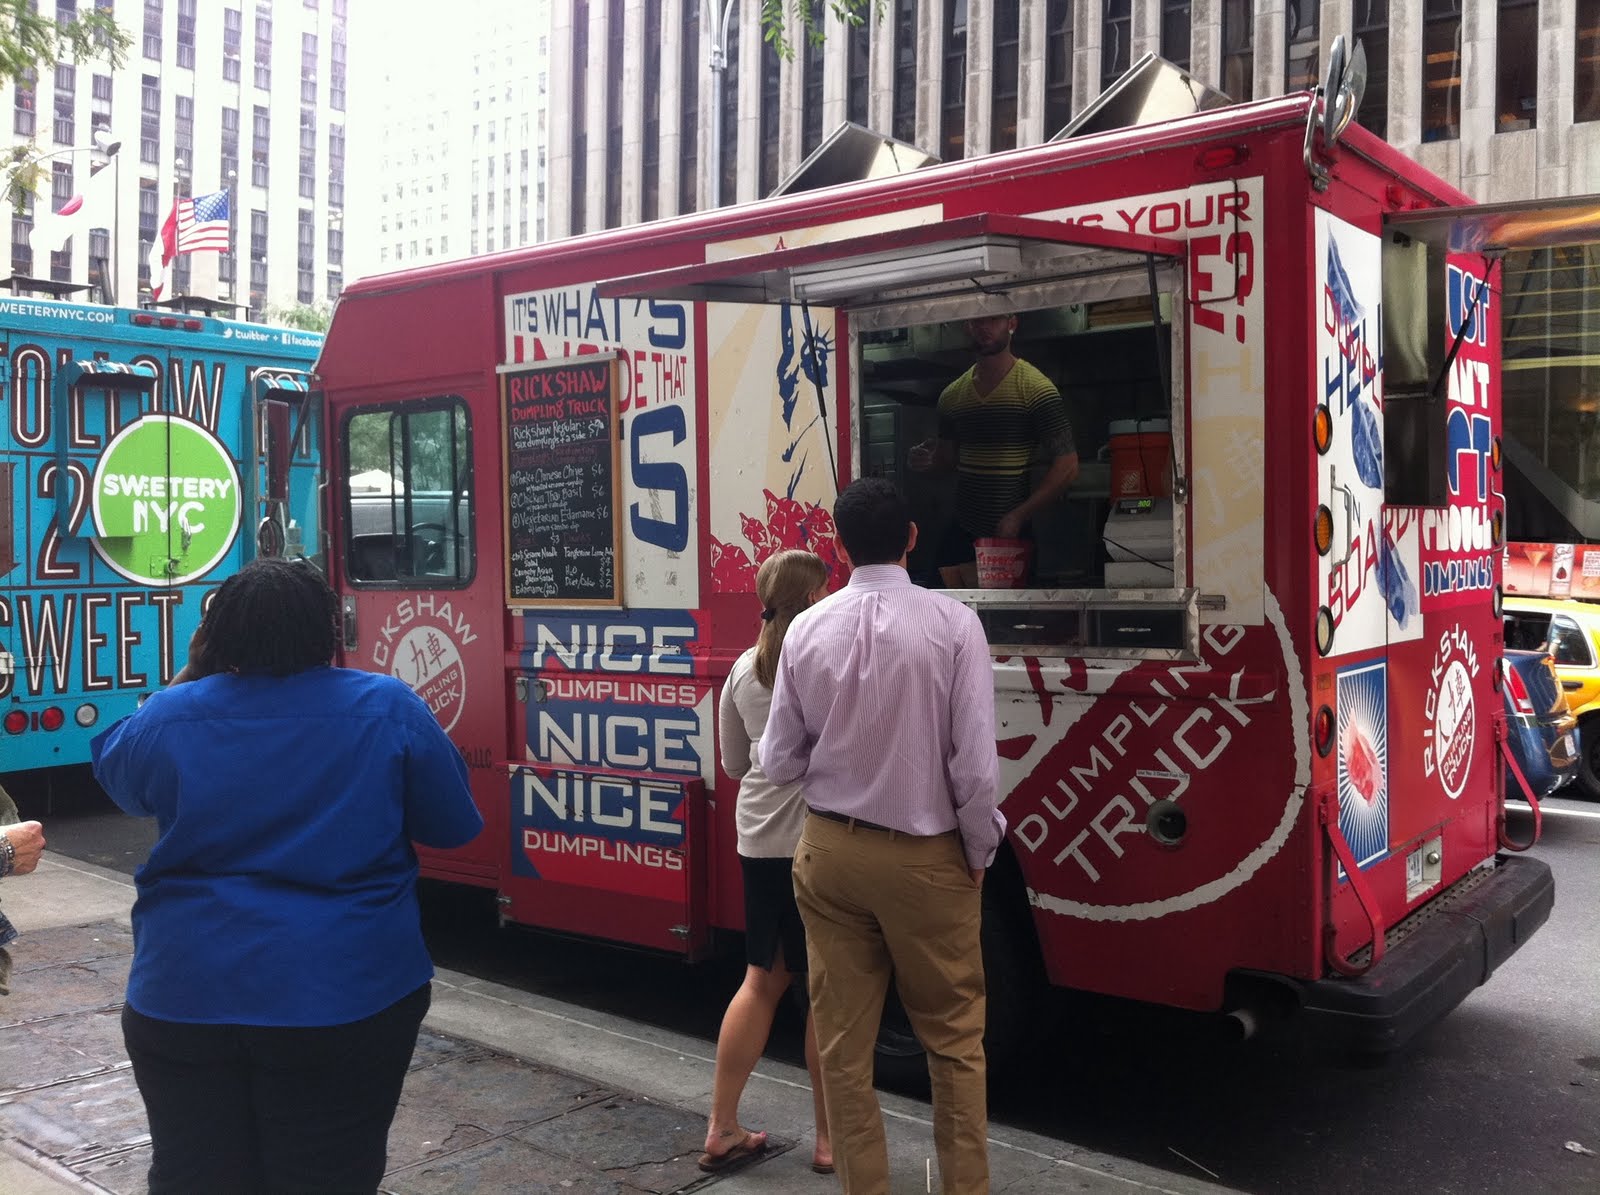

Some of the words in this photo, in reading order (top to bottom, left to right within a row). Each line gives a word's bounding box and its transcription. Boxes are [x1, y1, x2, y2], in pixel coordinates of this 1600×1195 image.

[1116, 191, 1253, 235] YOUR
[0, 303, 114, 324] WEETERYNYC.COM
[512, 296, 538, 333] IT'S
[1446, 264, 1491, 347] UST
[236, 328, 270, 343] twitter
[291, 332, 323, 347] facebook
[1325, 282, 1385, 416] DUMPL
[0, 343, 226, 450] OLLOW
[651, 353, 688, 404] THAT
[1447, 357, 1490, 409] AN'T
[567, 397, 608, 416] TRUCK
[1447, 406, 1491, 502] ET
[103, 473, 233, 499] SWEETERY
[562, 487, 582, 502] Basil
[132, 500, 206, 534] NYC
[1424, 556, 1493, 597] DUMPLINGS
[373, 594, 478, 667] CKSHAW
[533, 624, 695, 674] NICE
[423, 669, 459, 700] PLING
[428, 685, 460, 714] UCK
[545, 679, 697, 705] DUMPLINGS
[1424, 623, 1480, 778] RICKSHAW
[539, 711, 698, 772] NICE
[1014, 623, 1246, 853] DUMPLING
[1053, 665, 1277, 884] TRUCK
[524, 768, 683, 835] NICE
[524, 830, 683, 870] DUMPLINGS
